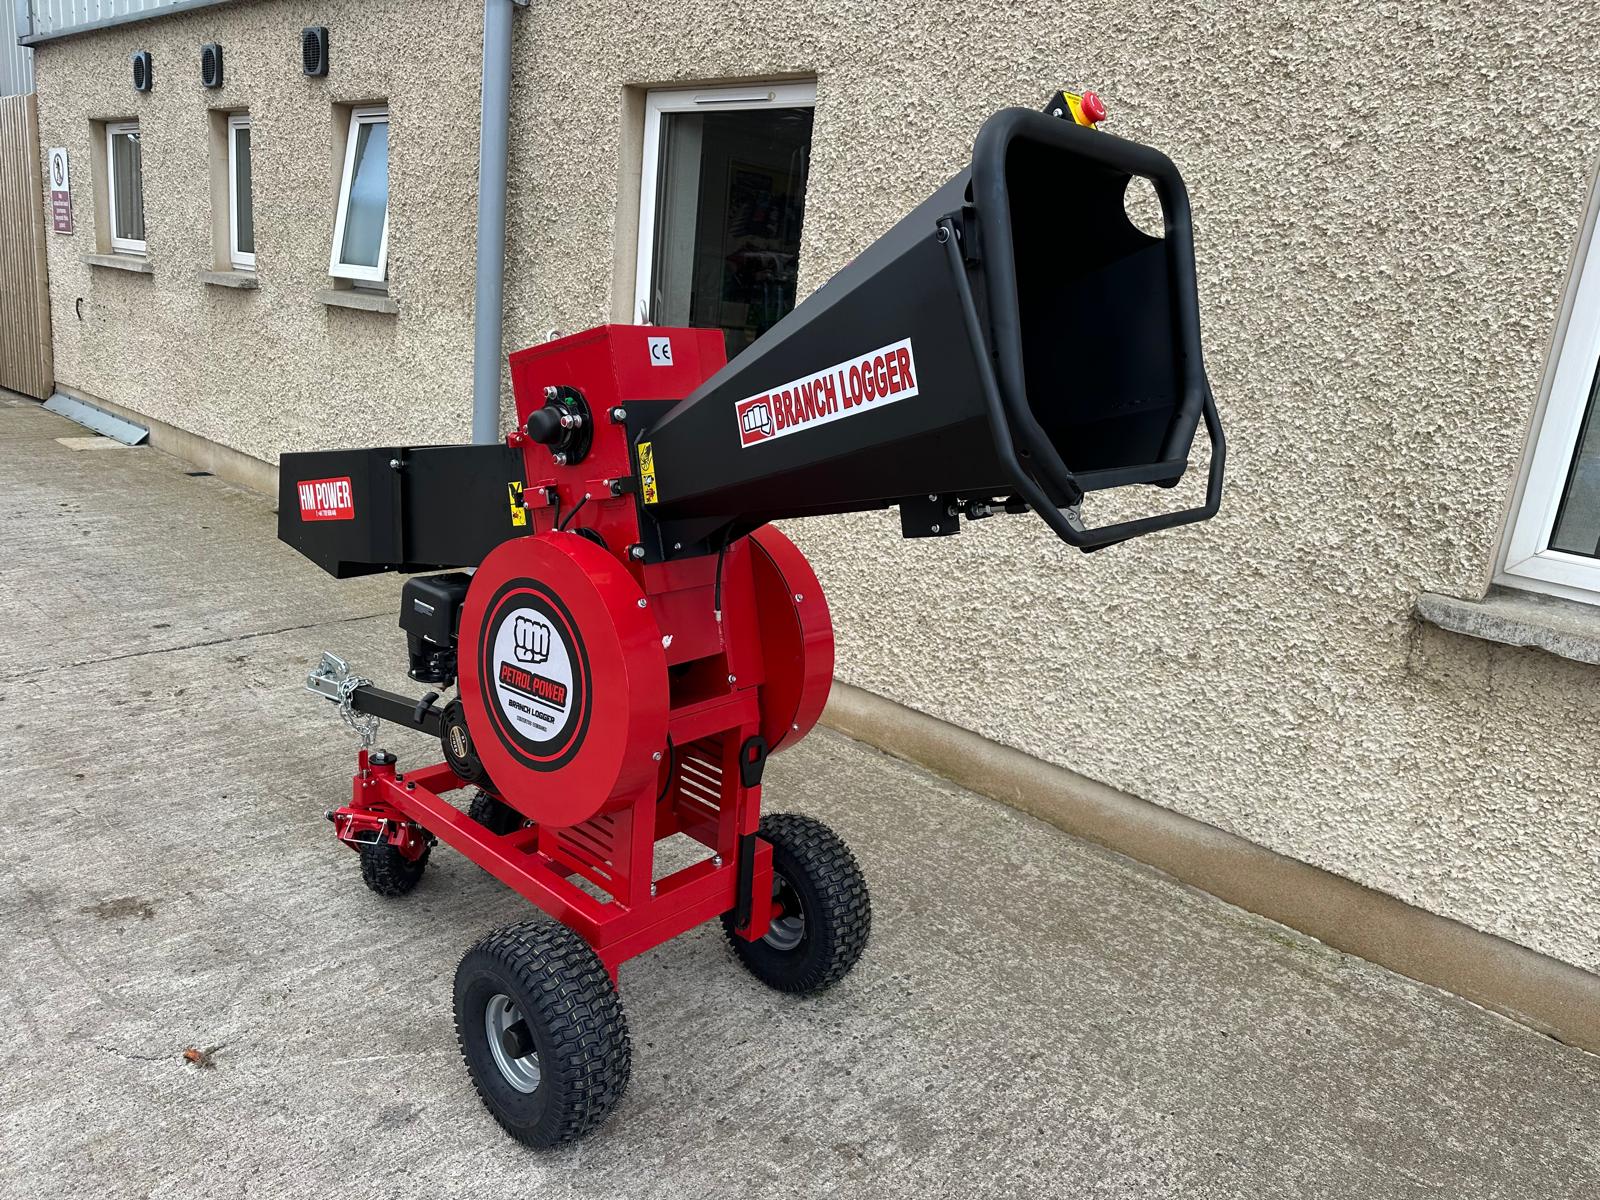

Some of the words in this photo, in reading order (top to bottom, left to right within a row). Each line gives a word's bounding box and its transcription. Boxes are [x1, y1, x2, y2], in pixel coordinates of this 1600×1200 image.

[652, 344, 670, 360] CE
[772, 374, 838, 430] BRANCH
[839, 347, 915, 409] LOGGER
[299, 484, 316, 510] HM
[315, 481, 351, 509] POWER
[501, 665, 531, 690] PETROL
[532, 677, 565, 703] POWER
[508, 698, 530, 714] BRANCH
[531, 708, 555, 724] LOGGER
